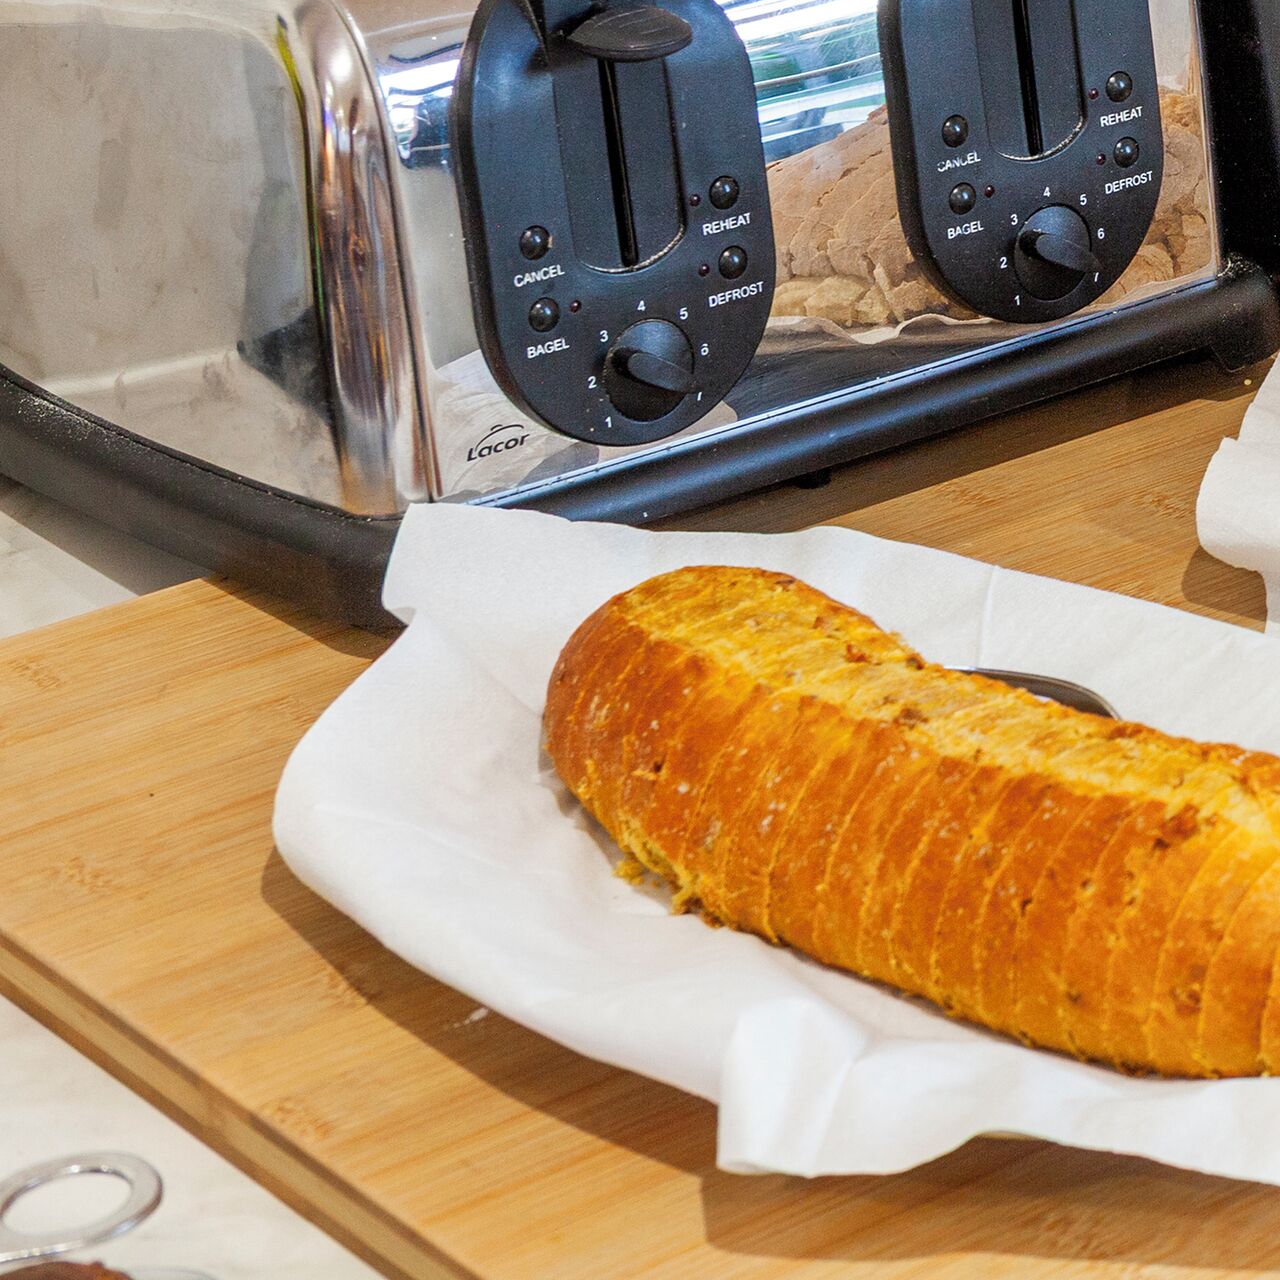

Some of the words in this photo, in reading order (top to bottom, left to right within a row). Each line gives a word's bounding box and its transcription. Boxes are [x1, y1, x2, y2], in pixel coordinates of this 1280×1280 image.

[1100, 106, 1142, 127] REHEAT
[938, 151, 981, 172] CANCEL
[1105, 171, 1152, 194] DEFROST
[1044, 187, 1050, 197] 4
[1080, 194, 1087, 205] 5
[703, 213, 750, 235] REHEAT
[1011, 214, 1018, 225] 3
[948, 221, 984, 239] BAGEL
[1098, 228, 1104, 239] 6
[1000, 257, 1007, 268] 2
[514, 265, 565, 287] CANCEL
[709, 282, 763, 307] DEFROST
[1015, 295, 1019, 305] 1
[638, 301, 645, 311] 4
[680, 308, 688, 319] 5
[600, 330, 608, 342] 3
[527, 338, 569, 358] BAGEL
[701, 344, 708, 355] 6
[588, 376, 596, 388] 2
[606, 417, 611, 427] 1
[467, 434, 530, 461] Lacor
